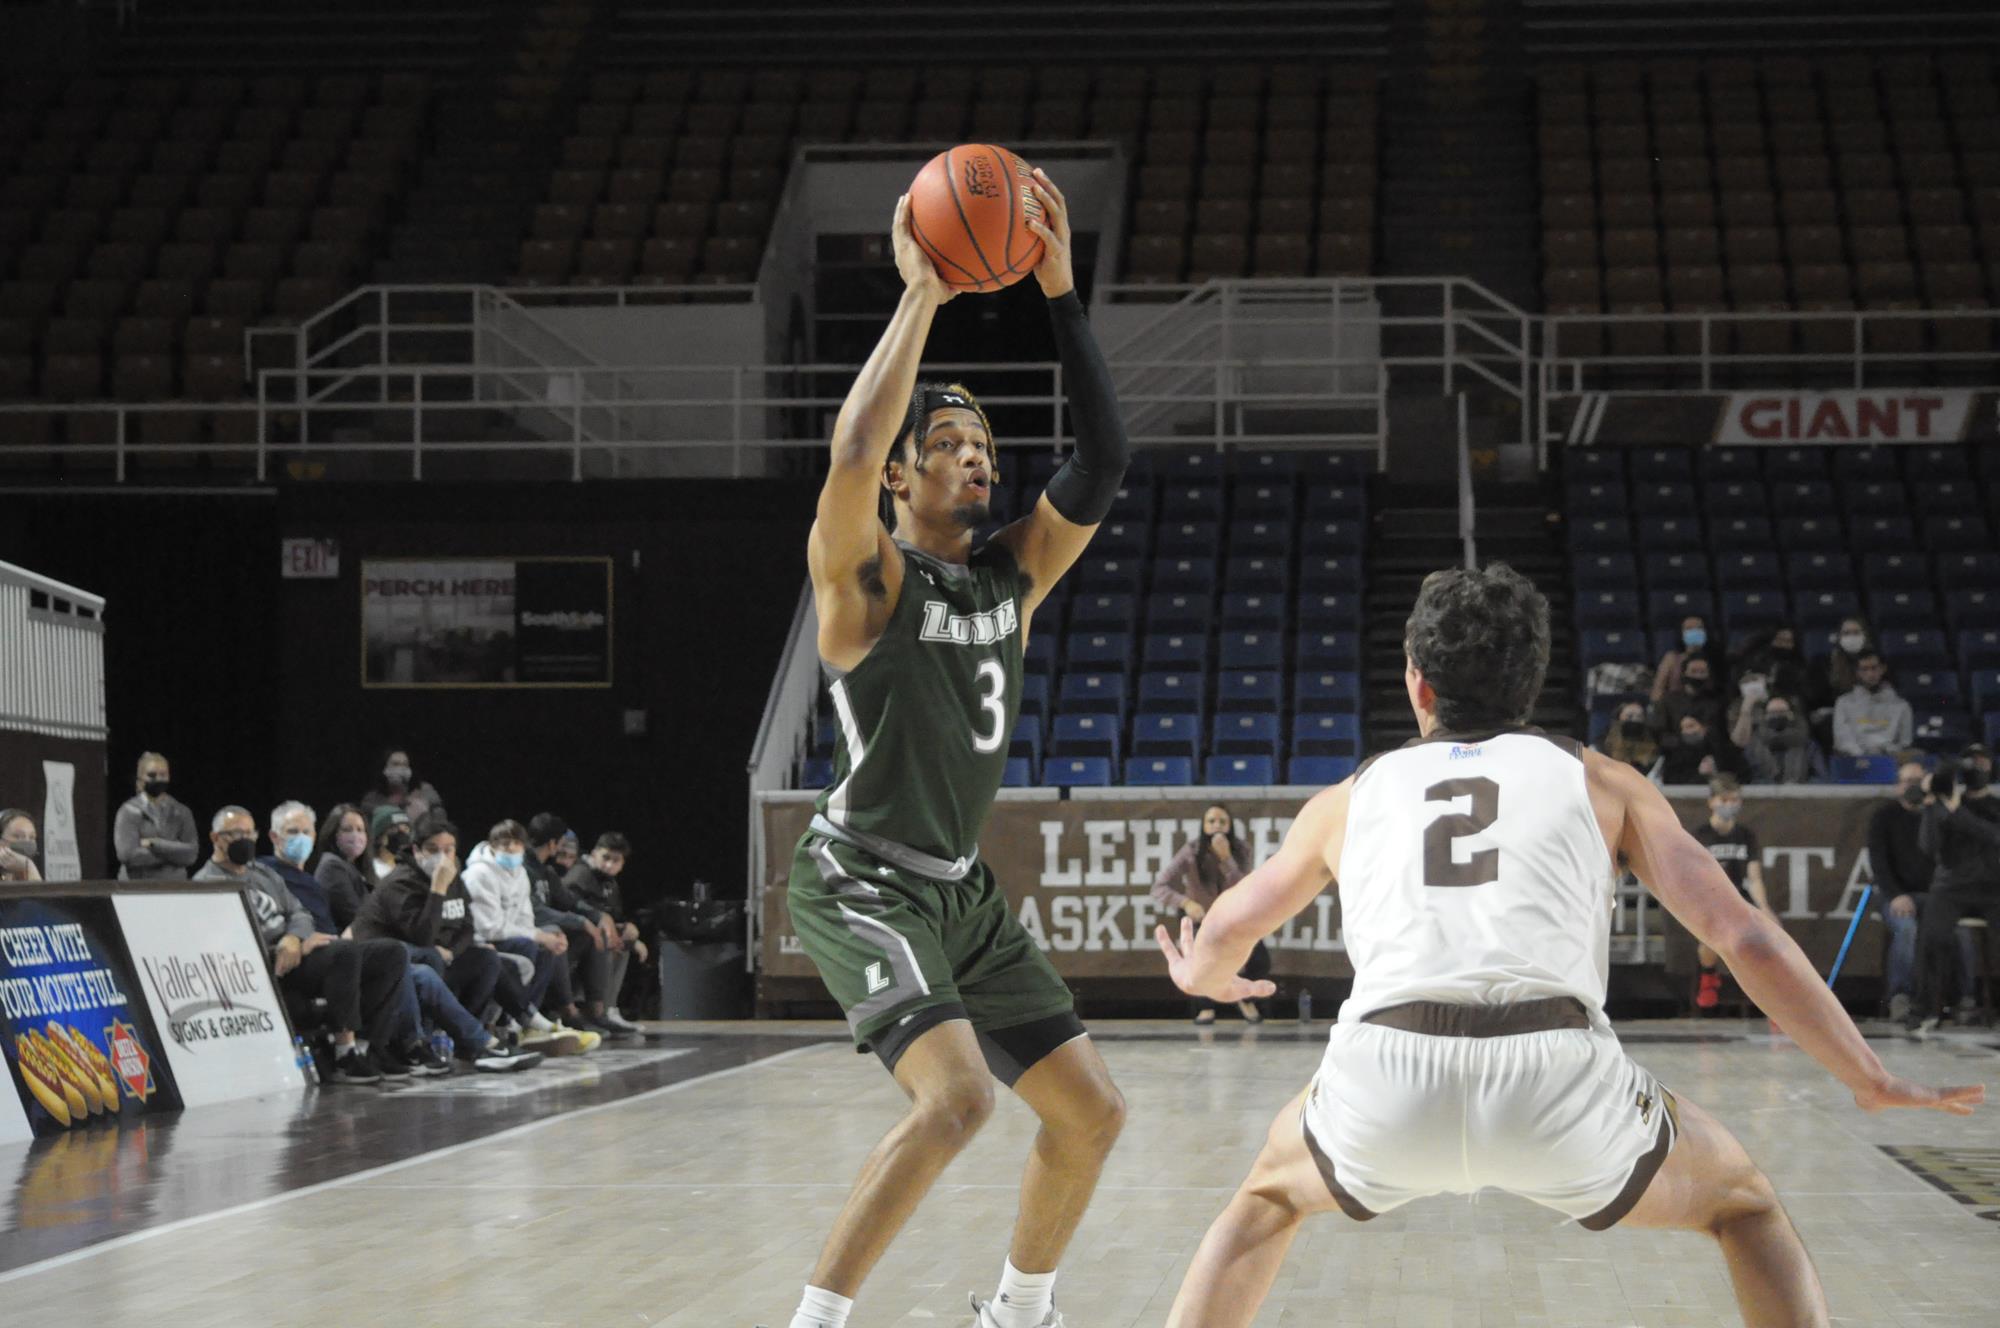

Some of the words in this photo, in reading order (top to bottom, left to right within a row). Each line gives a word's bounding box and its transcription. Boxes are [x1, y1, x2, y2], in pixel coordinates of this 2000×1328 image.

[1740, 398, 1943, 438] GIANT
[367, 578, 445, 597] PERCH
[451, 578, 516, 596] HERE
[971, 657, 1006, 754] 3
[1040, 818, 1297, 887] LEHH
[1423, 776, 1500, 887] 2
[0, 927, 53, 967] CHEER
[43, 923, 92, 963] WITH
[0, 977, 42, 1019] YOUR
[31, 971, 92, 1015] MOUTH
[141, 955, 211, 1018] Valley
[200, 951, 260, 1012] Wide
[865, 962, 890, 994] L
[170, 1019, 208, 1044] SIGNS
[208, 1017, 220, 1038] &
[219, 1011, 274, 1037] GRAPHICS
